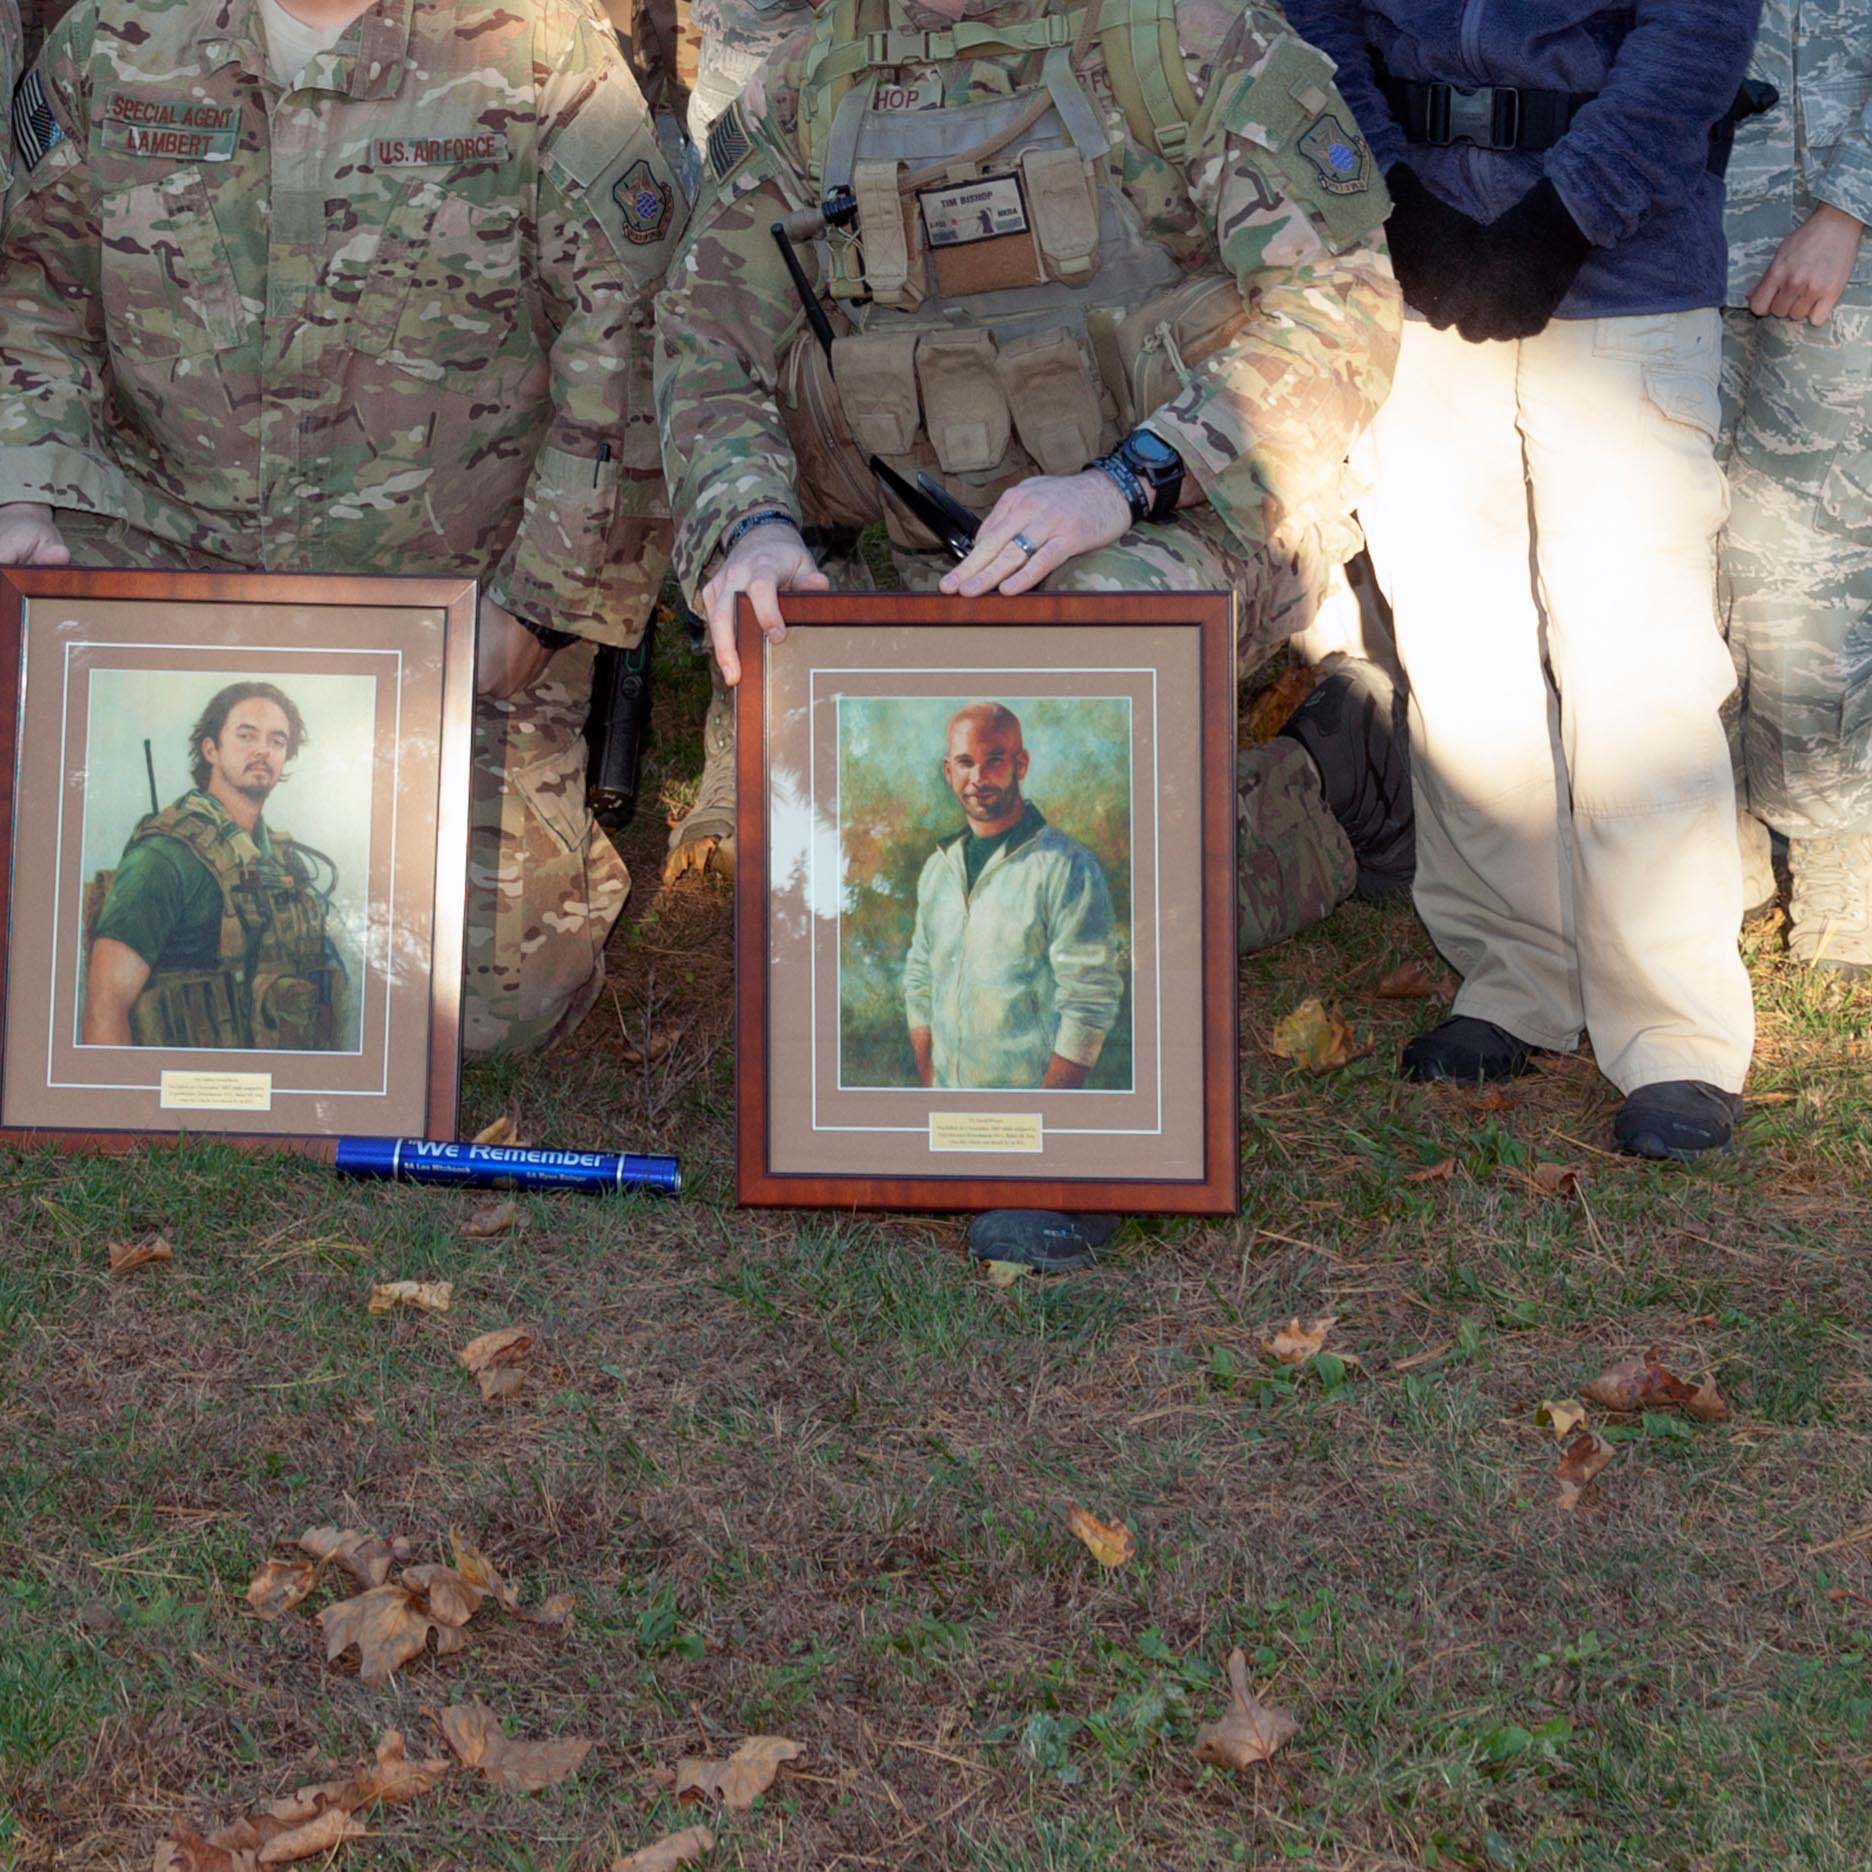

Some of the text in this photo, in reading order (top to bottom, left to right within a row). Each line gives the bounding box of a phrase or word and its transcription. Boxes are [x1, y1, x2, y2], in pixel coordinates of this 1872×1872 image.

[113, 95, 234, 128] SPECIAL AGENT
[127, 128, 214, 156] LAMBERT
[379, 135, 496, 164] U.S. AIR FORCE
